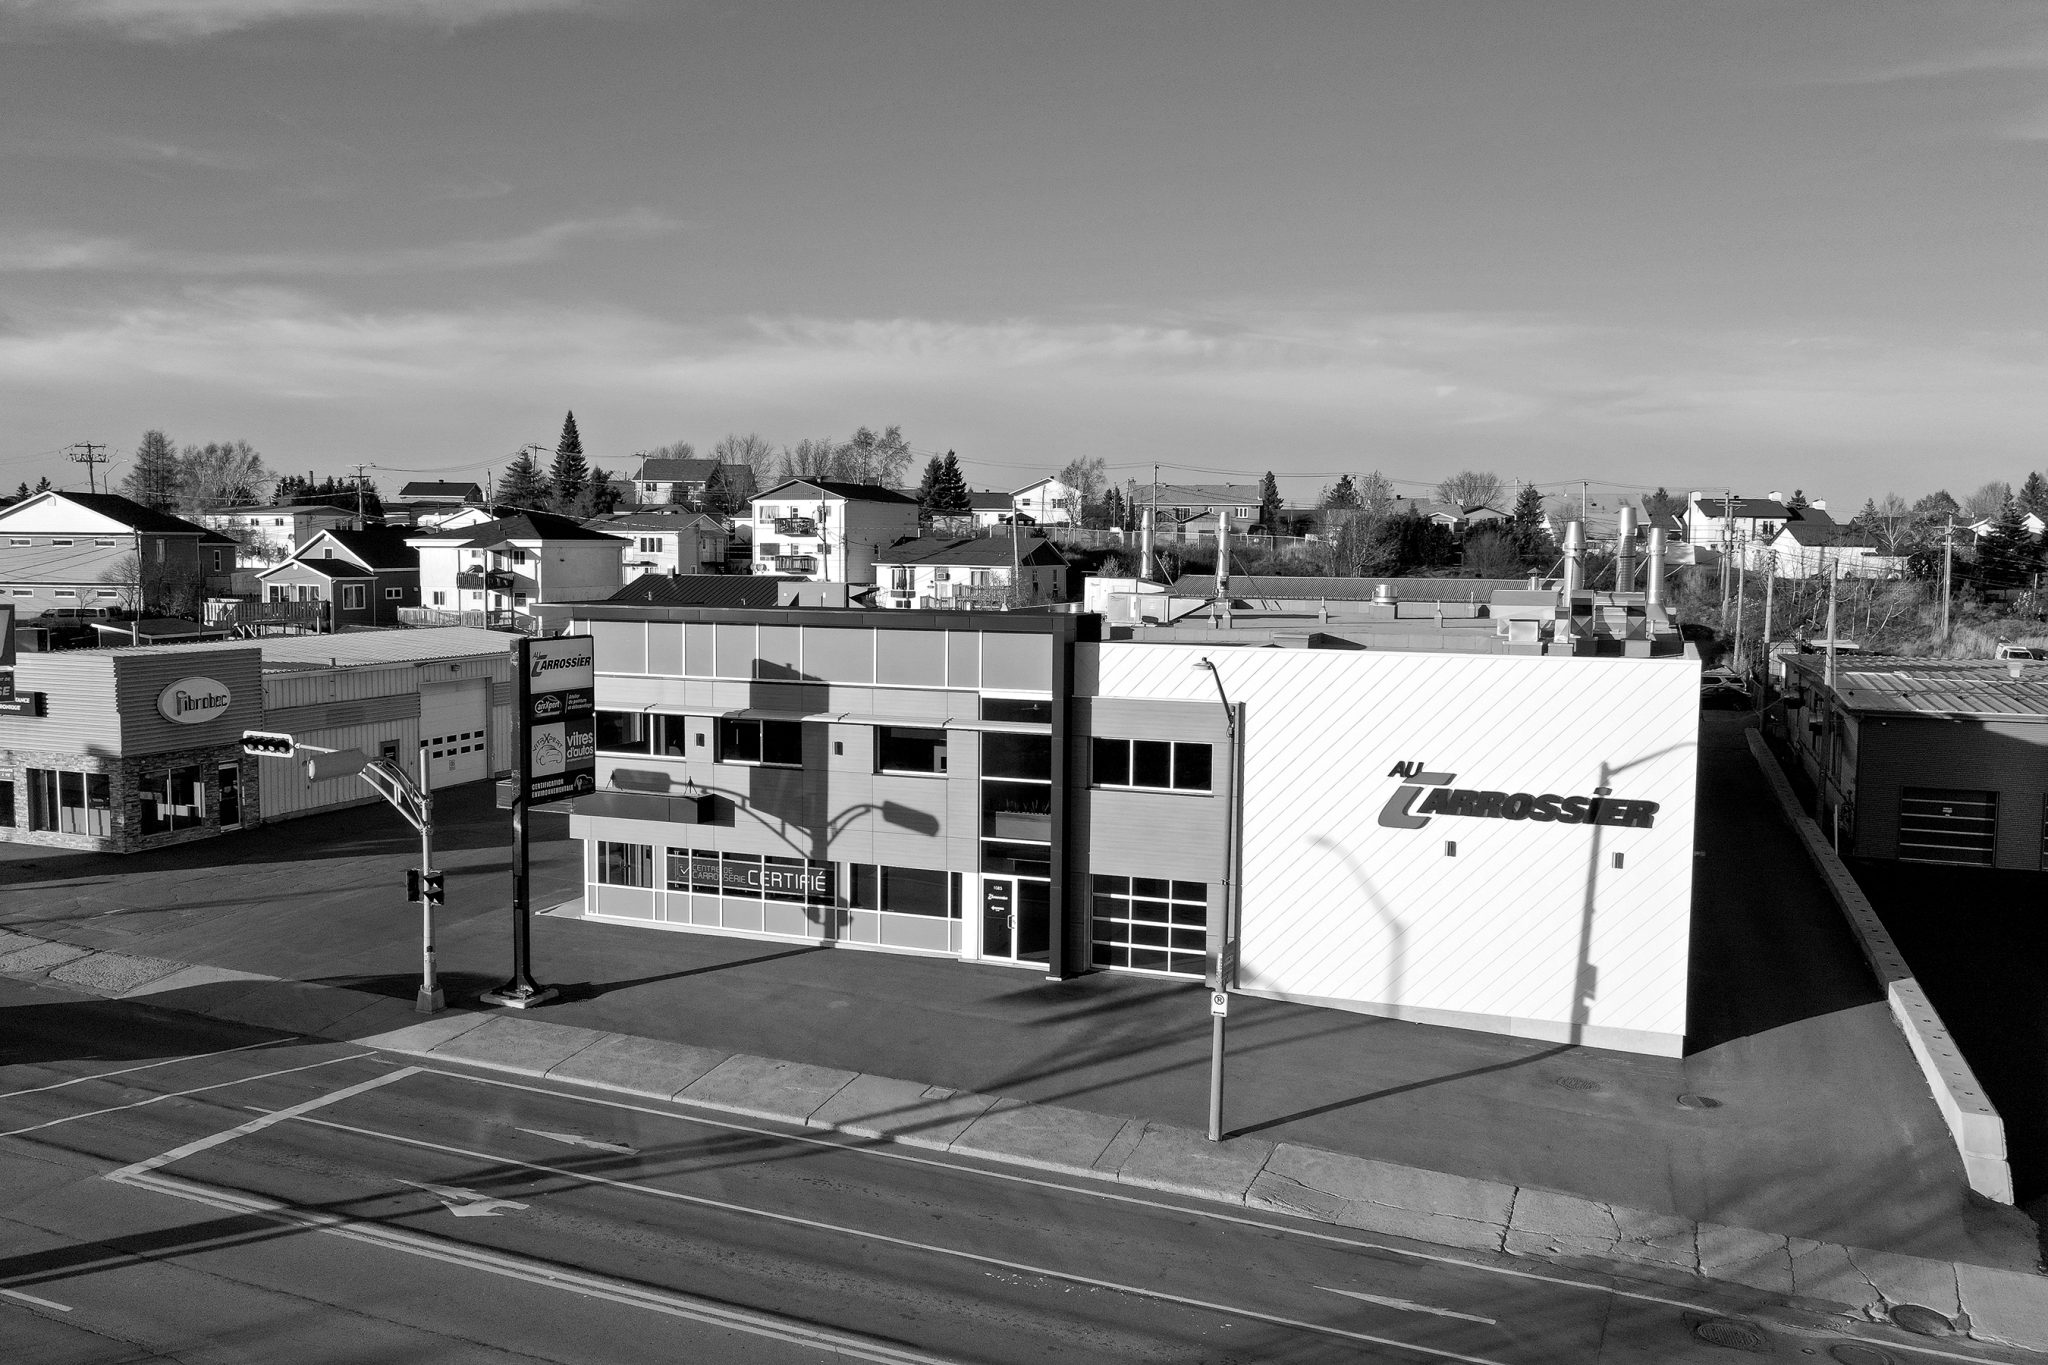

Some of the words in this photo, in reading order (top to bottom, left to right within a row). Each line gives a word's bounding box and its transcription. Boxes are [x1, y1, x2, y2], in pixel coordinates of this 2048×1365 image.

[531, 654, 591, 677] CARROSSIER
[567, 731, 593, 747] vitres
[567, 745, 593, 758] d'autos
[1387, 760, 1424, 778] AU
[1378, 772, 1660, 829] CARROSSIER
[723, 866, 733, 874] DE
[748, 869, 826, 892] CERTIFIÉ
